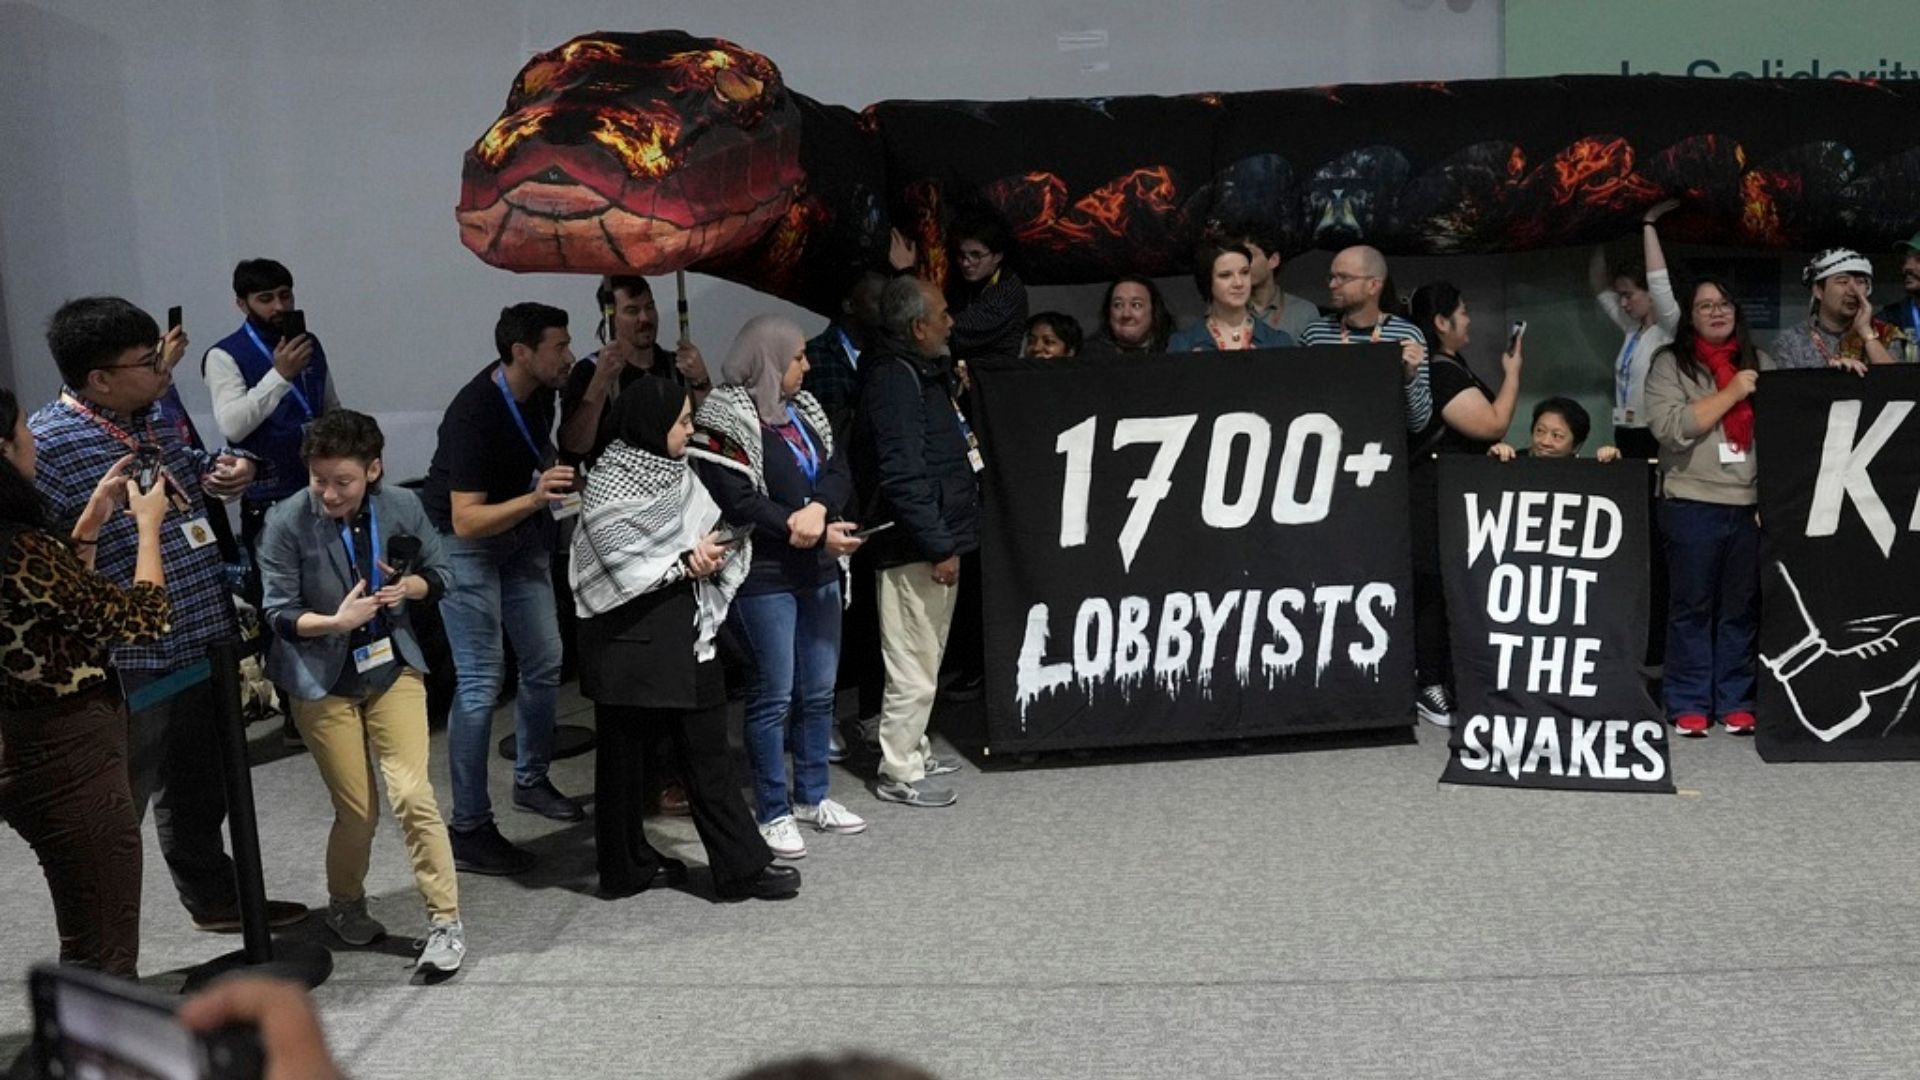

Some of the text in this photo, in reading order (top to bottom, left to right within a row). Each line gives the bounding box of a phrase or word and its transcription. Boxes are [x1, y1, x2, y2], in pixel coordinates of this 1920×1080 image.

[1056, 412, 1393, 574] 1700+
[1805, 399, 1920, 559] K
[1463, 490, 1623, 569] WEED
[1486, 560, 1599, 626] OUT
[1015, 581, 1398, 730] LOBBYISTS
[1487, 631, 1602, 698] THE
[1459, 714, 1668, 782] SNAKES
